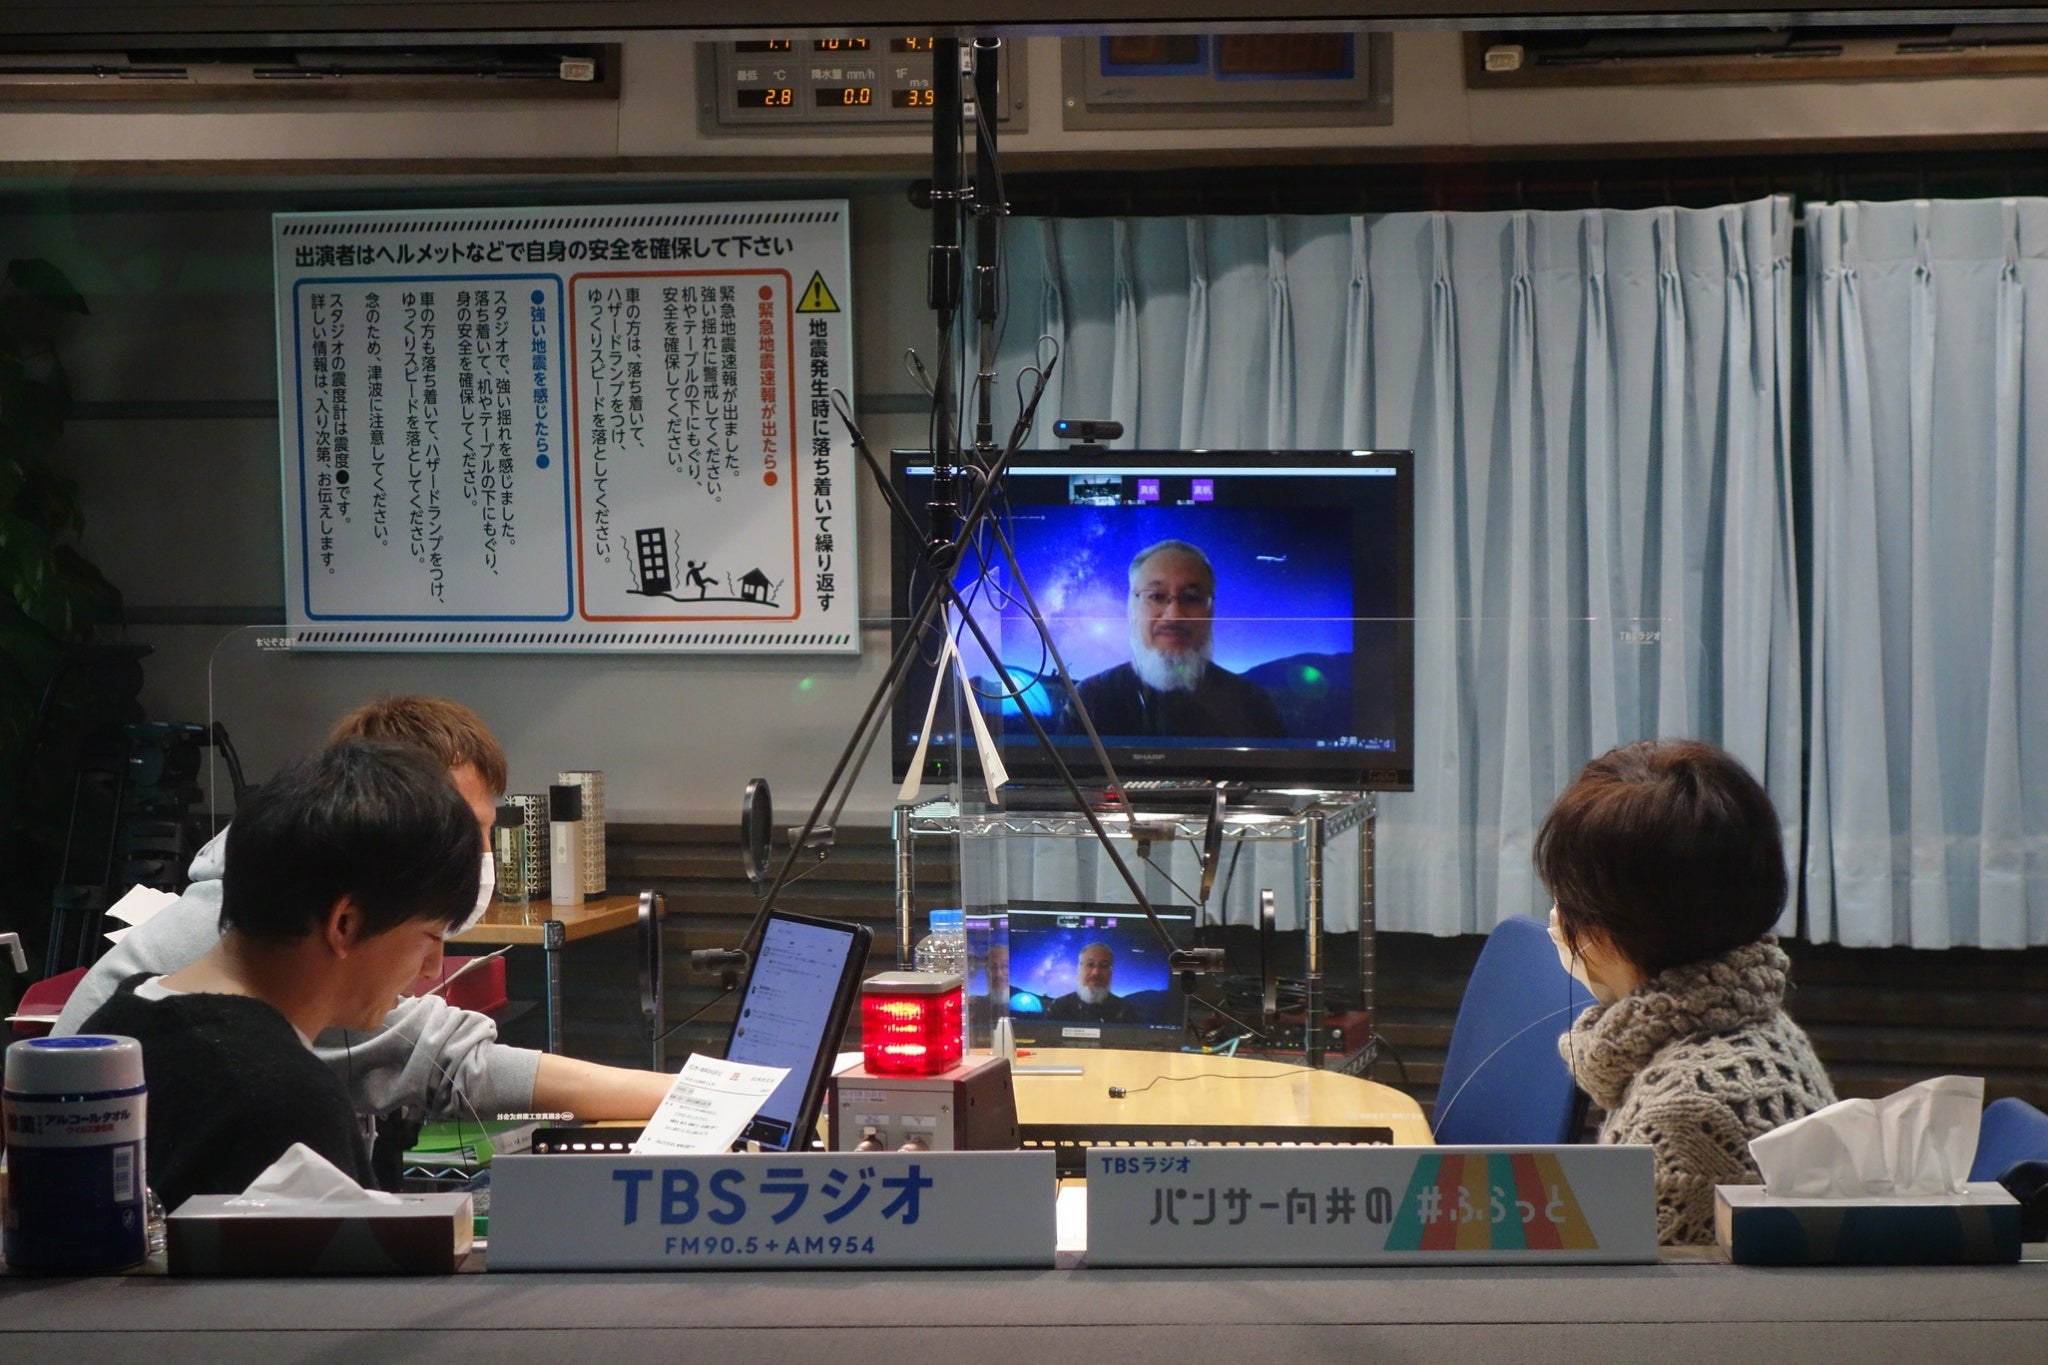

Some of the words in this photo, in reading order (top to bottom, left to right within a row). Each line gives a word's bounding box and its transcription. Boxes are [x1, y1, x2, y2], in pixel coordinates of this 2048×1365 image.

[765, 89, 791, 105] 2.8
[811, 69, 842, 80] 降水量
[843, 88, 871, 104] 0.0
[908, 89, 934, 106] 3.9
[295, 235, 793, 267] 出演者はヘルメットなどで自身の安全を確保して下さい
[310, 293, 335, 575] 詳しい情報は、入り次第、お伝えします。
[364, 292, 389, 547] 念のため、津波に注意してください。
[401, 292, 425, 563] ゆっくりスピードを落としてください。
[419, 291, 445, 604] 車の方も落ち着いて、ハザードランプをつけ、
[457, 290, 478, 507] 身の安全を確保してください。
[474, 290, 498, 576] 落ち着いて、机やテーブルの下にもぐり、
[493, 290, 515, 545] スタジオで、強い揺れを感じました。
[588, 287, 611, 564] ゆっくりスピードを落としてください。
[607, 287, 627, 450] ハザードランプをつけ、
[625, 287, 645, 448] 車の方は、落ち着いて、
[662, 286, 683, 474] 安全を確保してください。
[681, 286, 703, 487] 机やテーブルの下にもぐり、
[701, 286, 722, 503] 強い揺れに警戒してください。
[719, 285, 740, 478] 緊急地震速報が出ました。
[809, 318, 835, 612] 地震発生時に落ち着いて繰り返す
[612, 1164, 934, 1226] TBSラジオ
[1101, 1156, 1191, 1174] TBSラジオ
